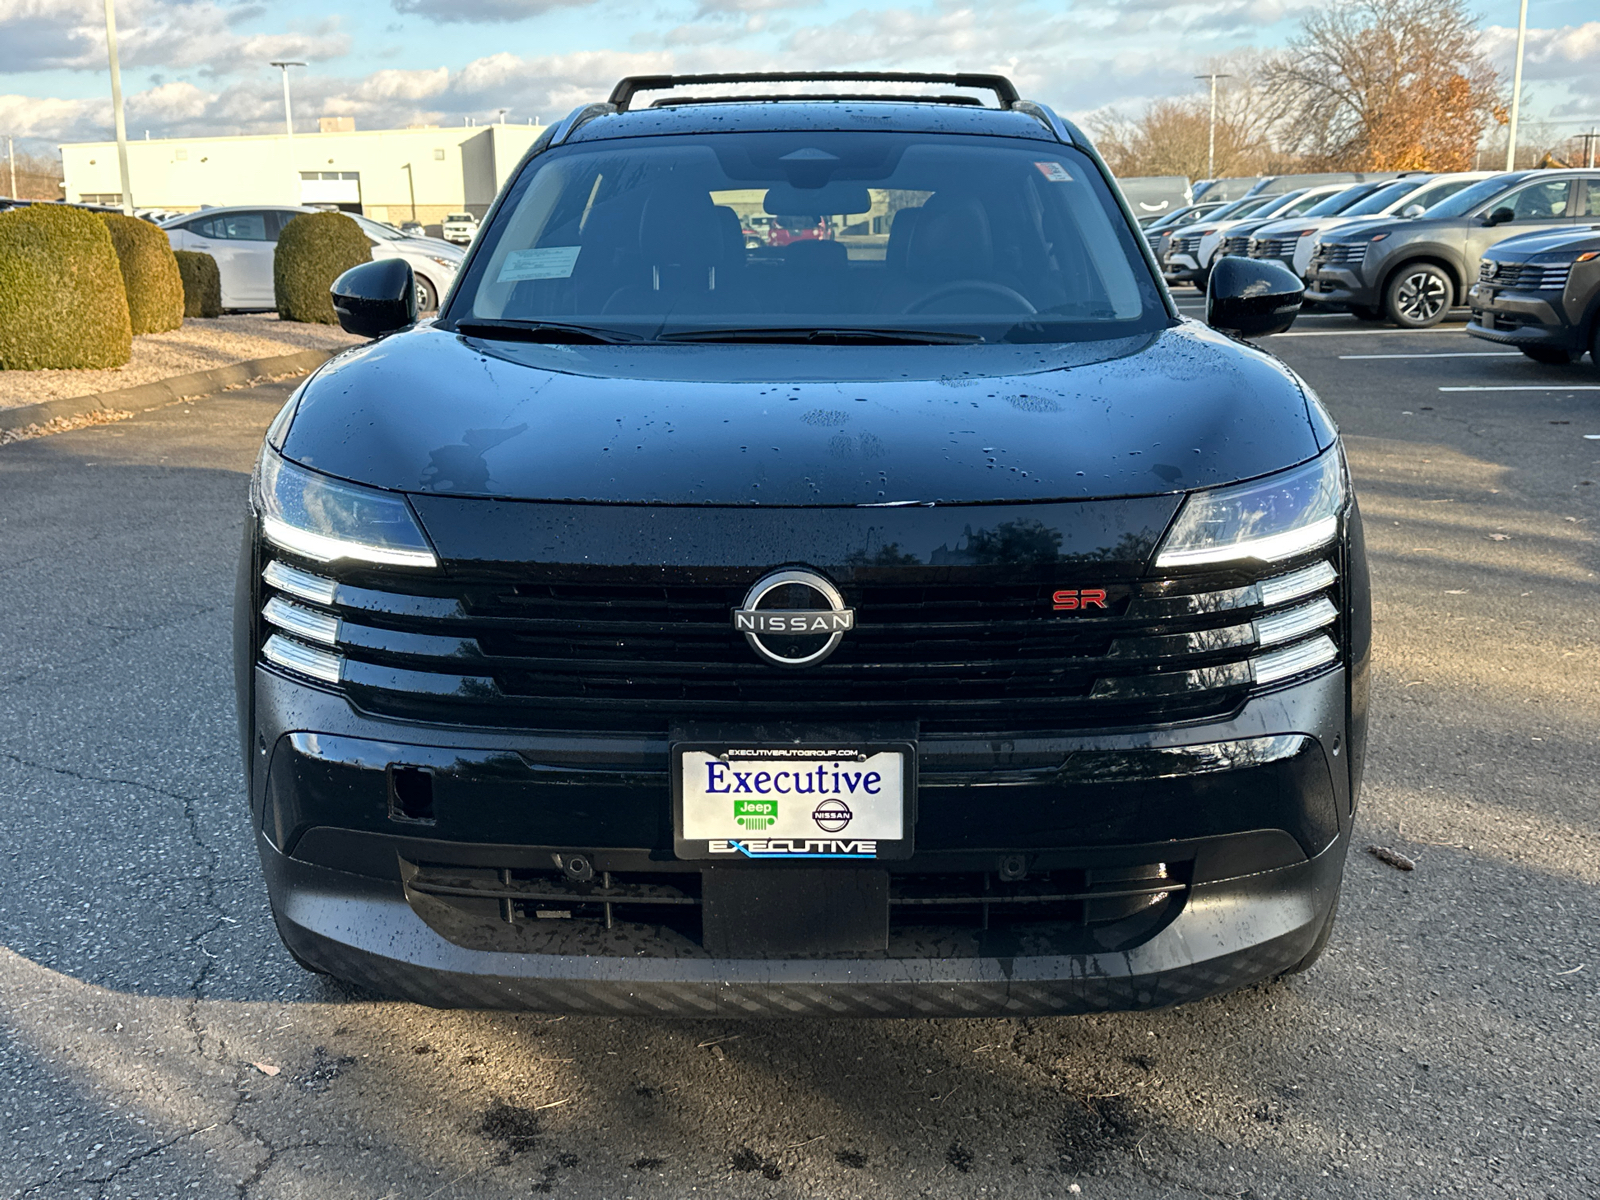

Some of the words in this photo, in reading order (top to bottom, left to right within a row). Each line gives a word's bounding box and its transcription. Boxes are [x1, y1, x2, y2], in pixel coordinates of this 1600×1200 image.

[1052, 588, 1108, 611] SR
[737, 614, 851, 631] NISSAN
[728, 749, 858, 757] EXECUTIVEAUTOGROUP.COM
[705, 761, 882, 795] Executive
[740, 801, 772, 814] Jeep
[708, 840, 877, 854] EXECUTIVE
